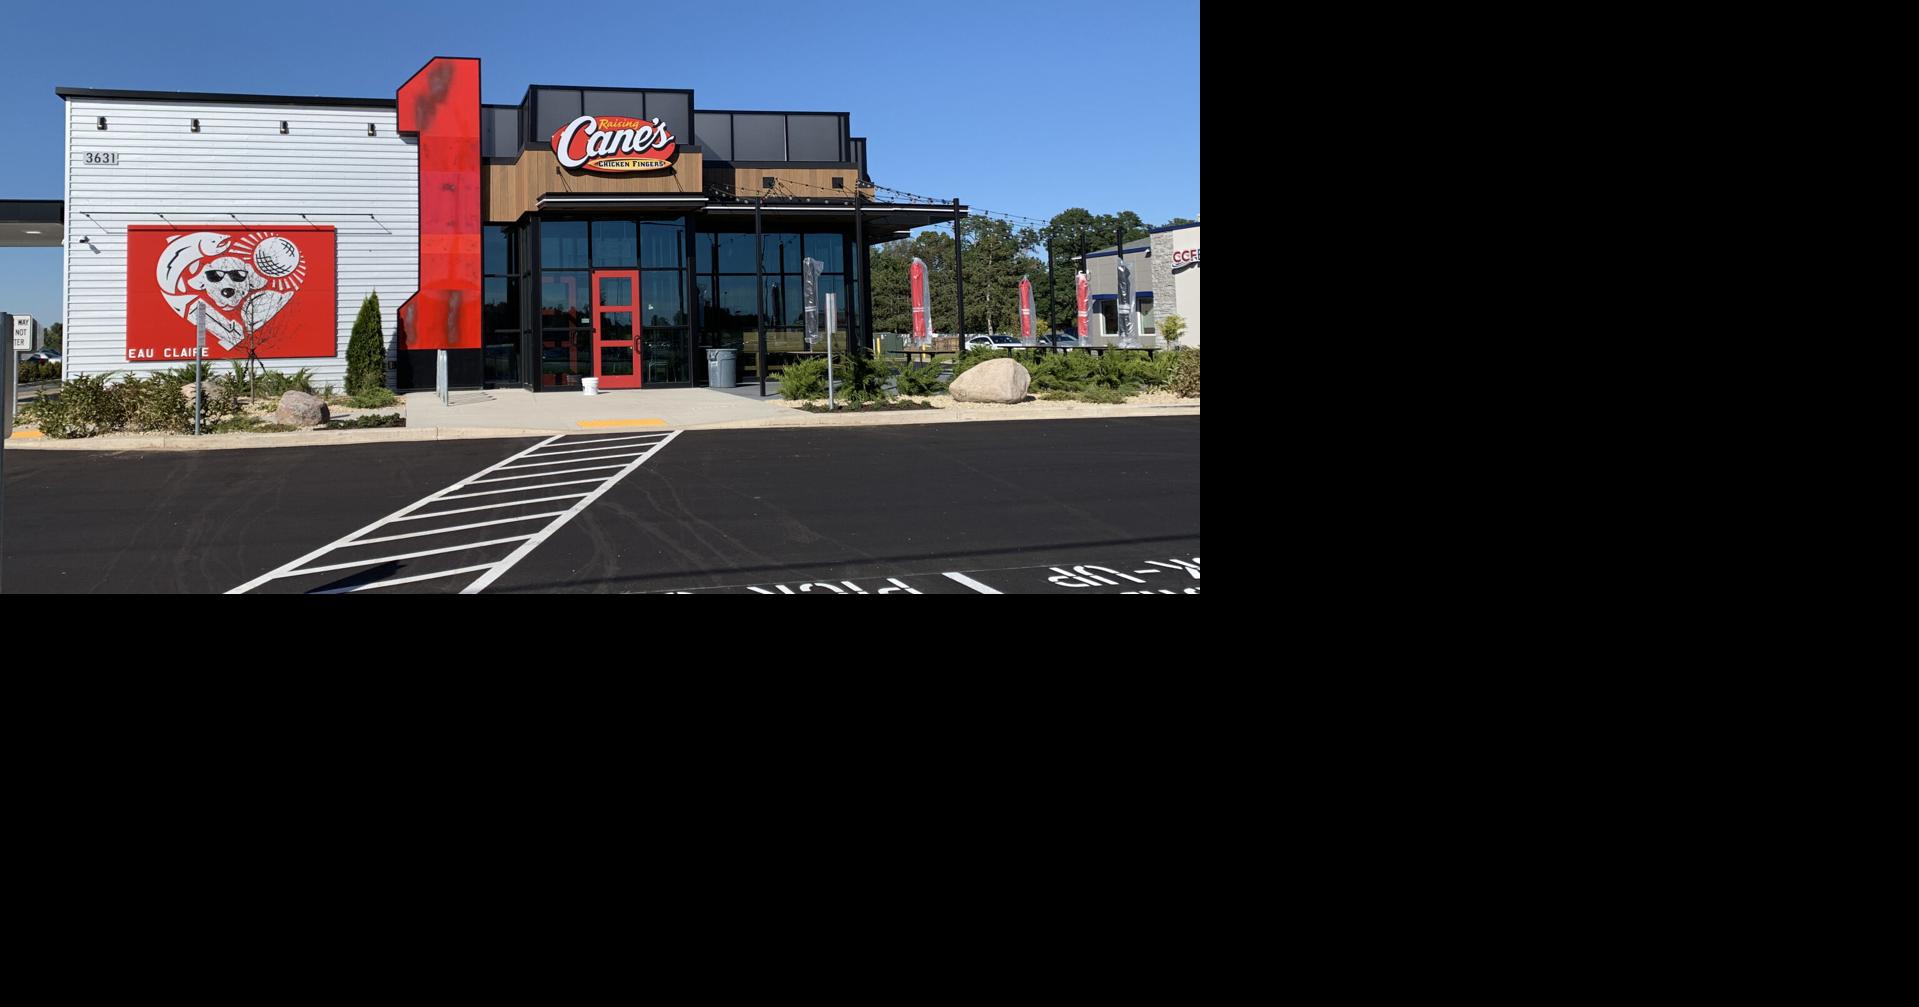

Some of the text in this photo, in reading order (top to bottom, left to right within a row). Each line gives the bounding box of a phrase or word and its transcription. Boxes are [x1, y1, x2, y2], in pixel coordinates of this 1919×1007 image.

[598, 119, 640, 130] Raising
[557, 115, 675, 168] Cane's
[86, 152, 115, 164] 3631
[128, 348, 154, 358] EAU
